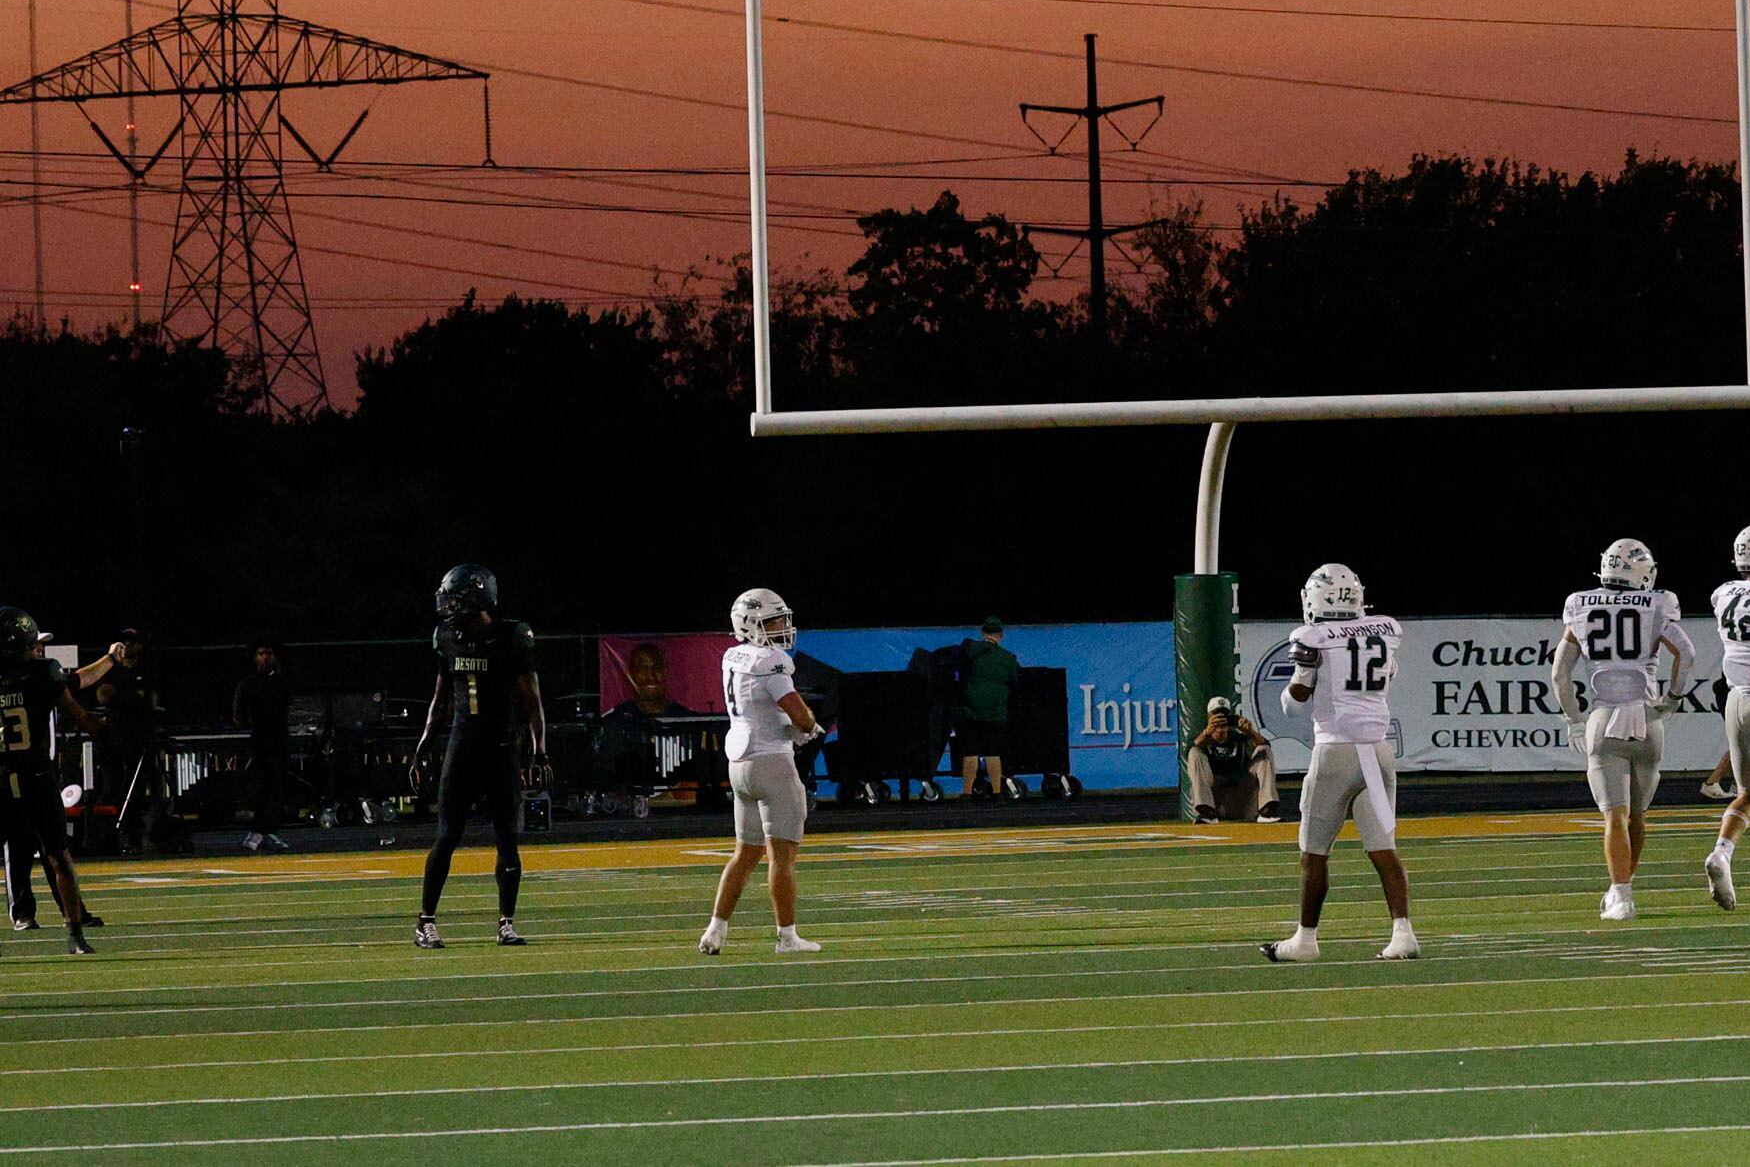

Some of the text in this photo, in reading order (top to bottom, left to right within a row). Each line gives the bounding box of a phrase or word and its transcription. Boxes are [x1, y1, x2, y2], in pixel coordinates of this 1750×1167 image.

[1338, 587, 1351, 601] 12
[1580, 595, 1652, 608] TOLLESON
[1327, 622, 1396, 640] J.JOHNSON
[1587, 608, 1642, 661] 20
[454, 657, 489, 672] DESOTO
[1345, 635, 1388, 691] 12
[1432, 639, 1557, 667] Chuck
[465, 674, 479, 715] 1
[0, 706, 32, 753] 3
[1079, 682, 1177, 751] Injur
